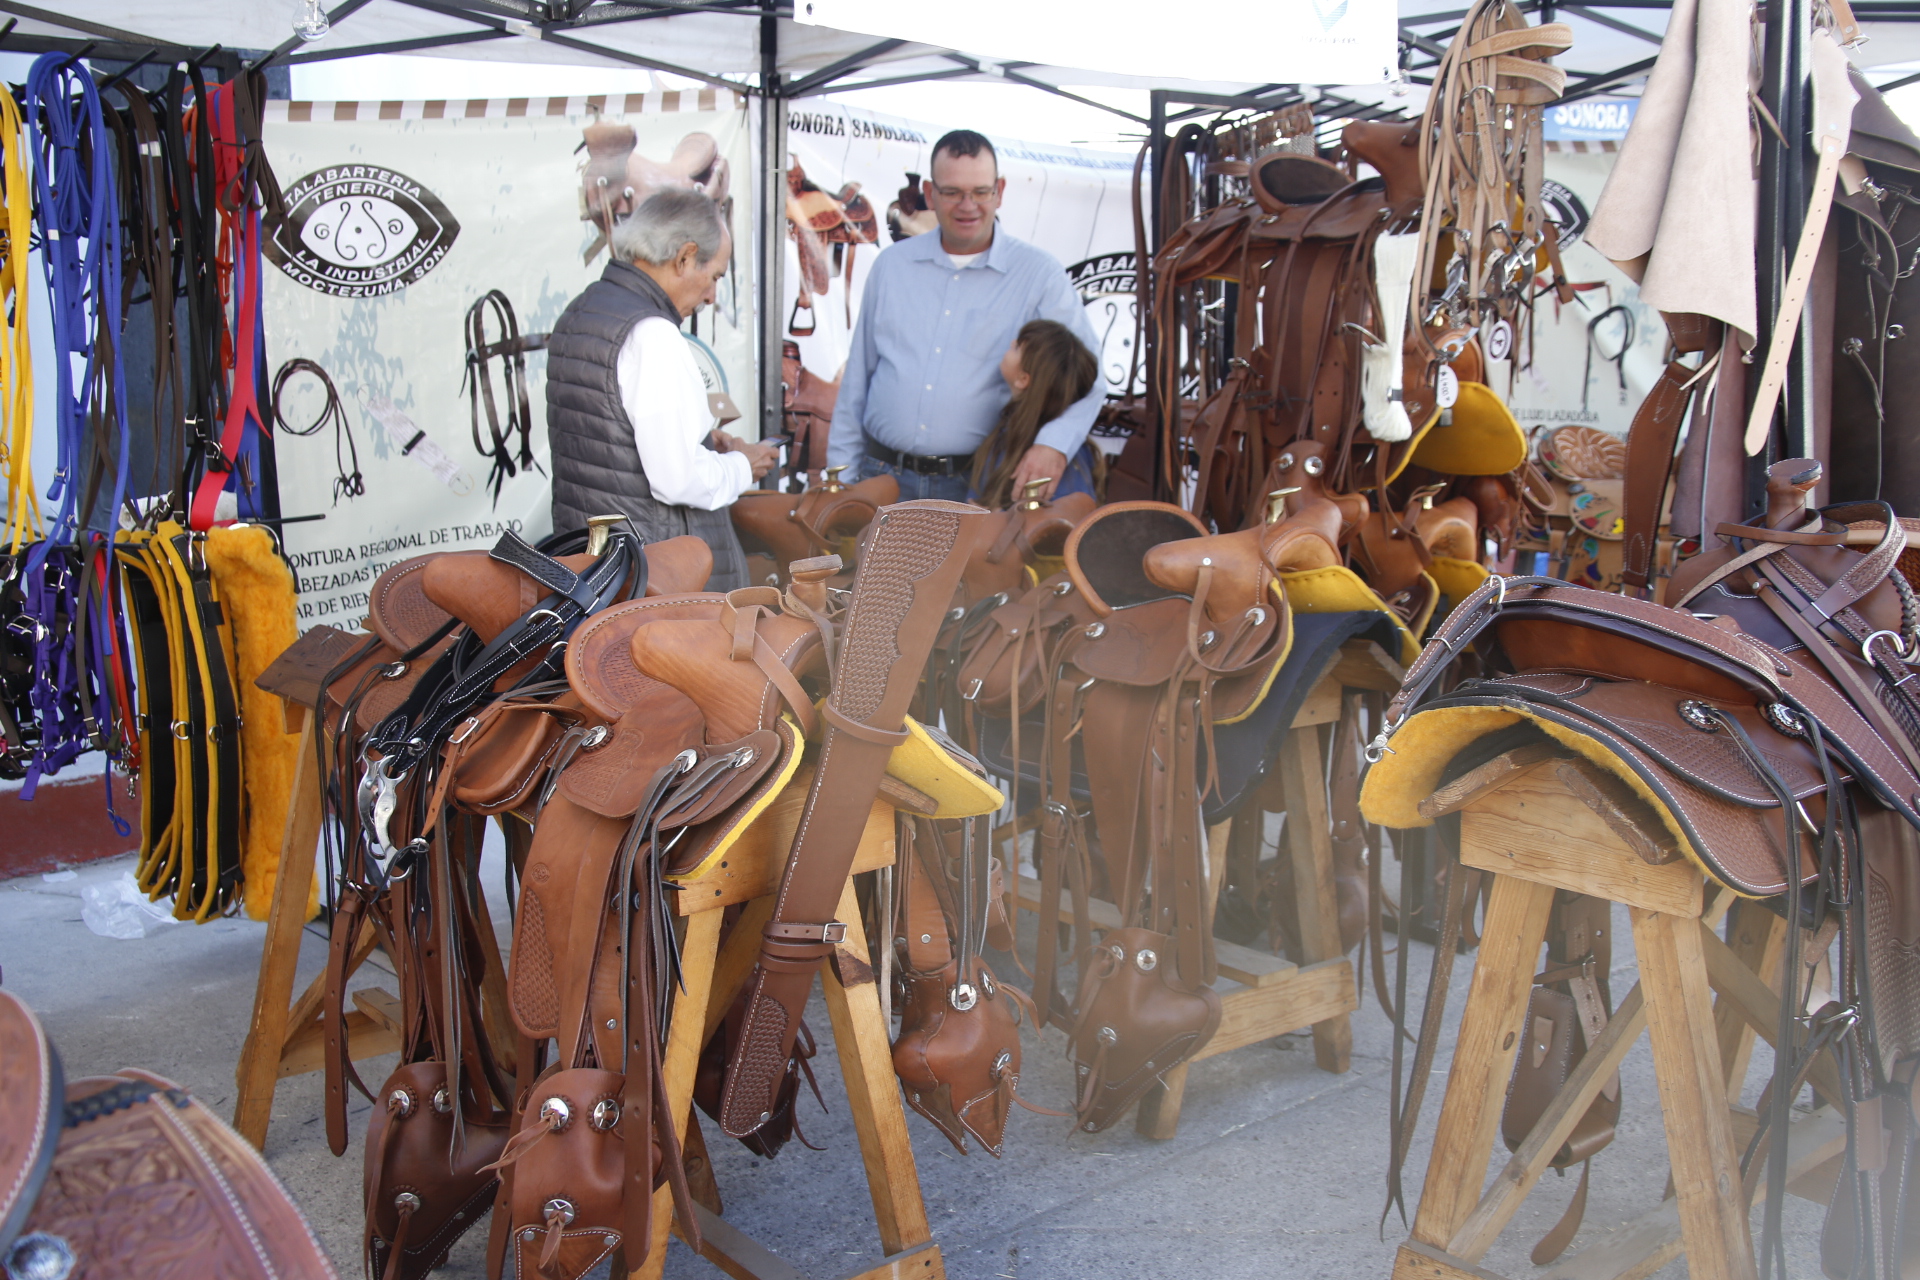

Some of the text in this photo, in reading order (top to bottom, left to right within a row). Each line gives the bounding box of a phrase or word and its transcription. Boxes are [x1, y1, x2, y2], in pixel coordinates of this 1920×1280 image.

[1554, 102, 1630, 130] SONORA
[284, 166, 421, 207] TALABARTERIA
[311, 182, 395, 205] TENERIA
[282, 244, 449, 297] MOCTEZUMA, SON.
[296, 237, 429, 281] LA INDUSTRIAL
[286, 518, 523, 569] ONTURA REGIONAL DE TRABAJO
[299, 567, 370, 594] BEZADAS
[318, 596, 338, 616] DE
